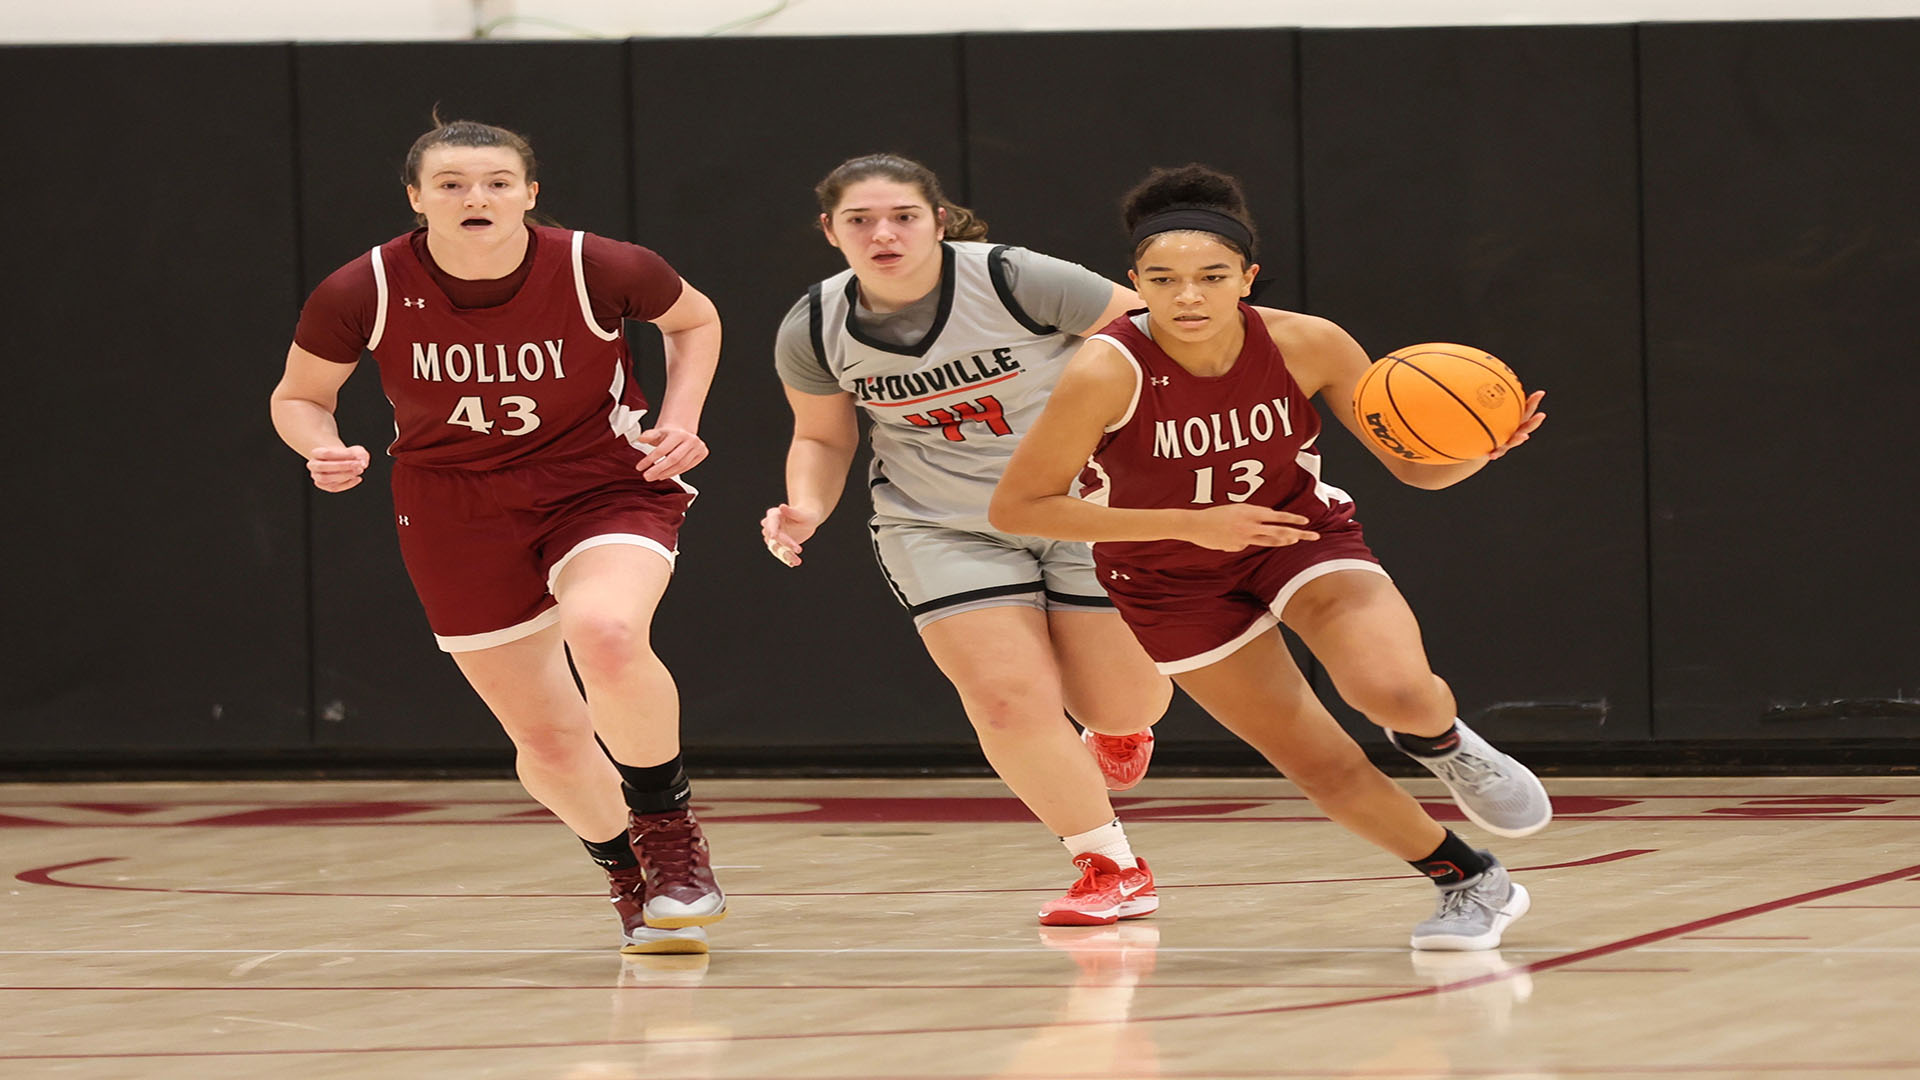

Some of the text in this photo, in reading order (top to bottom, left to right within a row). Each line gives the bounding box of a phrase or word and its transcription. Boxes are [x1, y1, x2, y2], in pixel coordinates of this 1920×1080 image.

[412, 338, 566, 383] MOLLOY
[446, 395, 541, 436] 43
[902, 395, 1013, 442] 44
[1152, 396, 1293, 459] MOLLOY
[1366, 412, 1425, 460] NCAA
[1190, 459, 1265, 503] 13
